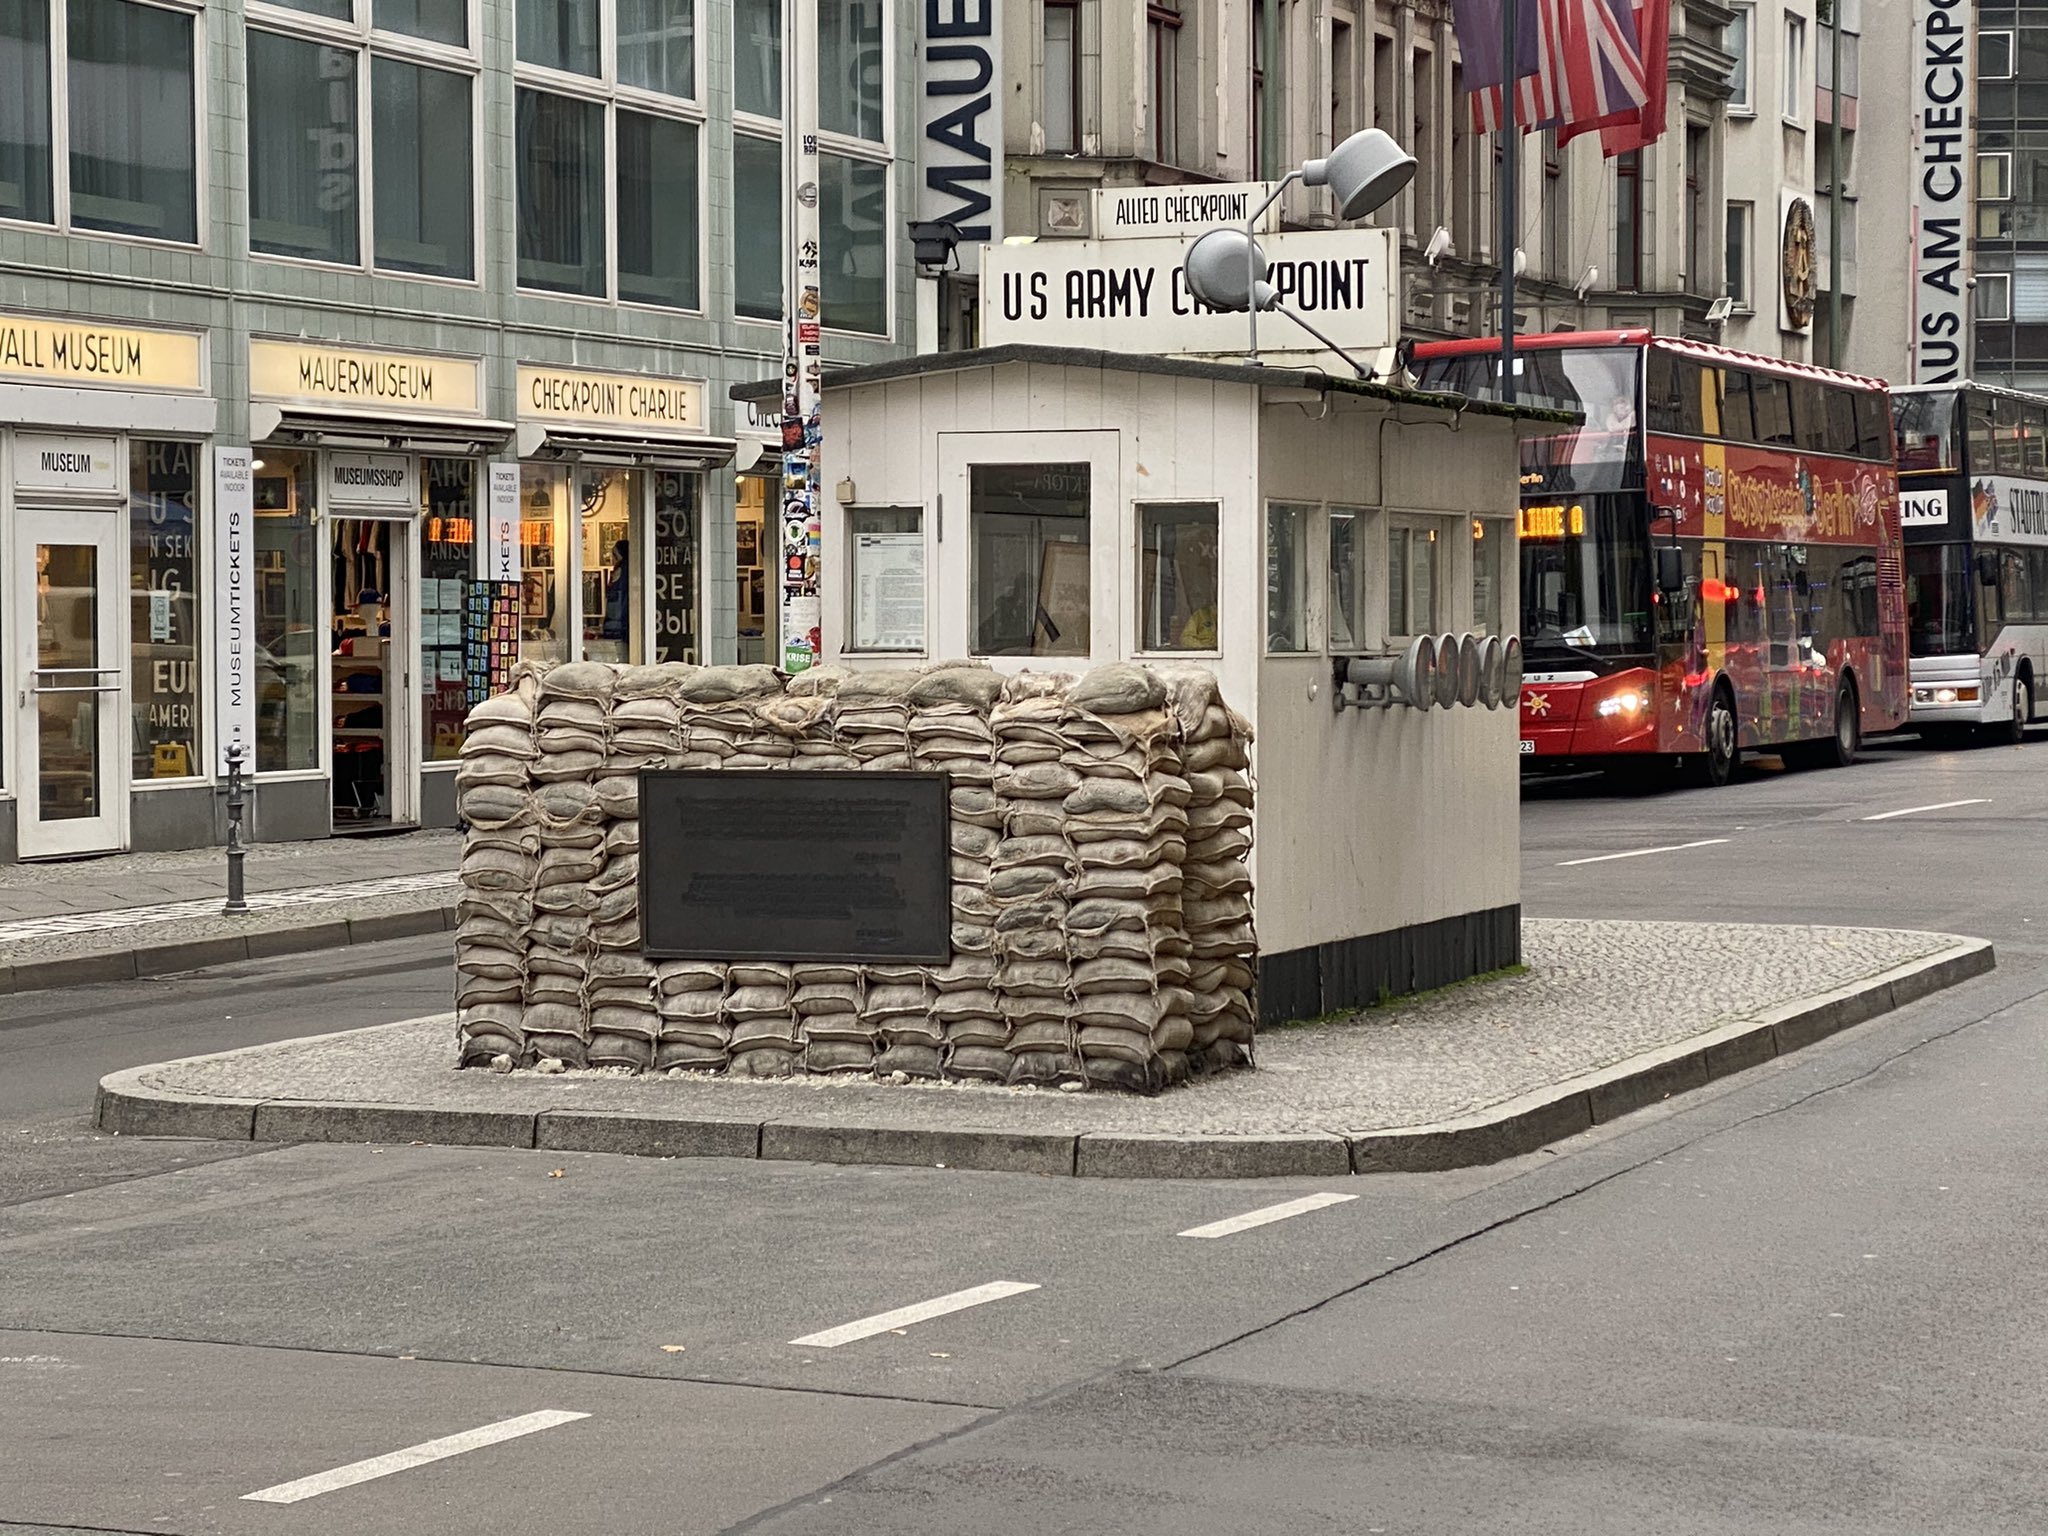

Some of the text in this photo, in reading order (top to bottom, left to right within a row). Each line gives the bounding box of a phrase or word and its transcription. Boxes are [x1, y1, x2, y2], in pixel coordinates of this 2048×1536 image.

[1115, 192, 1249, 226] ALLIED CHECKPOINT
[1922, 218, 1961, 296] AM
[1066, 266, 1155, 319] ARMY
[52, 331, 141, 376] MUSEUM
[299, 355, 433, 401] MAUERMUSEUM
[532, 377, 687, 421] CHECKPOINT CHARLIE
[41, 451, 91, 473] MUSEUM
[223, 457, 246, 467] TICKETS
[334, 466, 404, 488] MUSEUMSSHOP
[495, 472, 515, 481] TICKETS
[229, 511, 241, 706] MUSEUMTICKETS
[786, 652, 811, 664] KRISE
